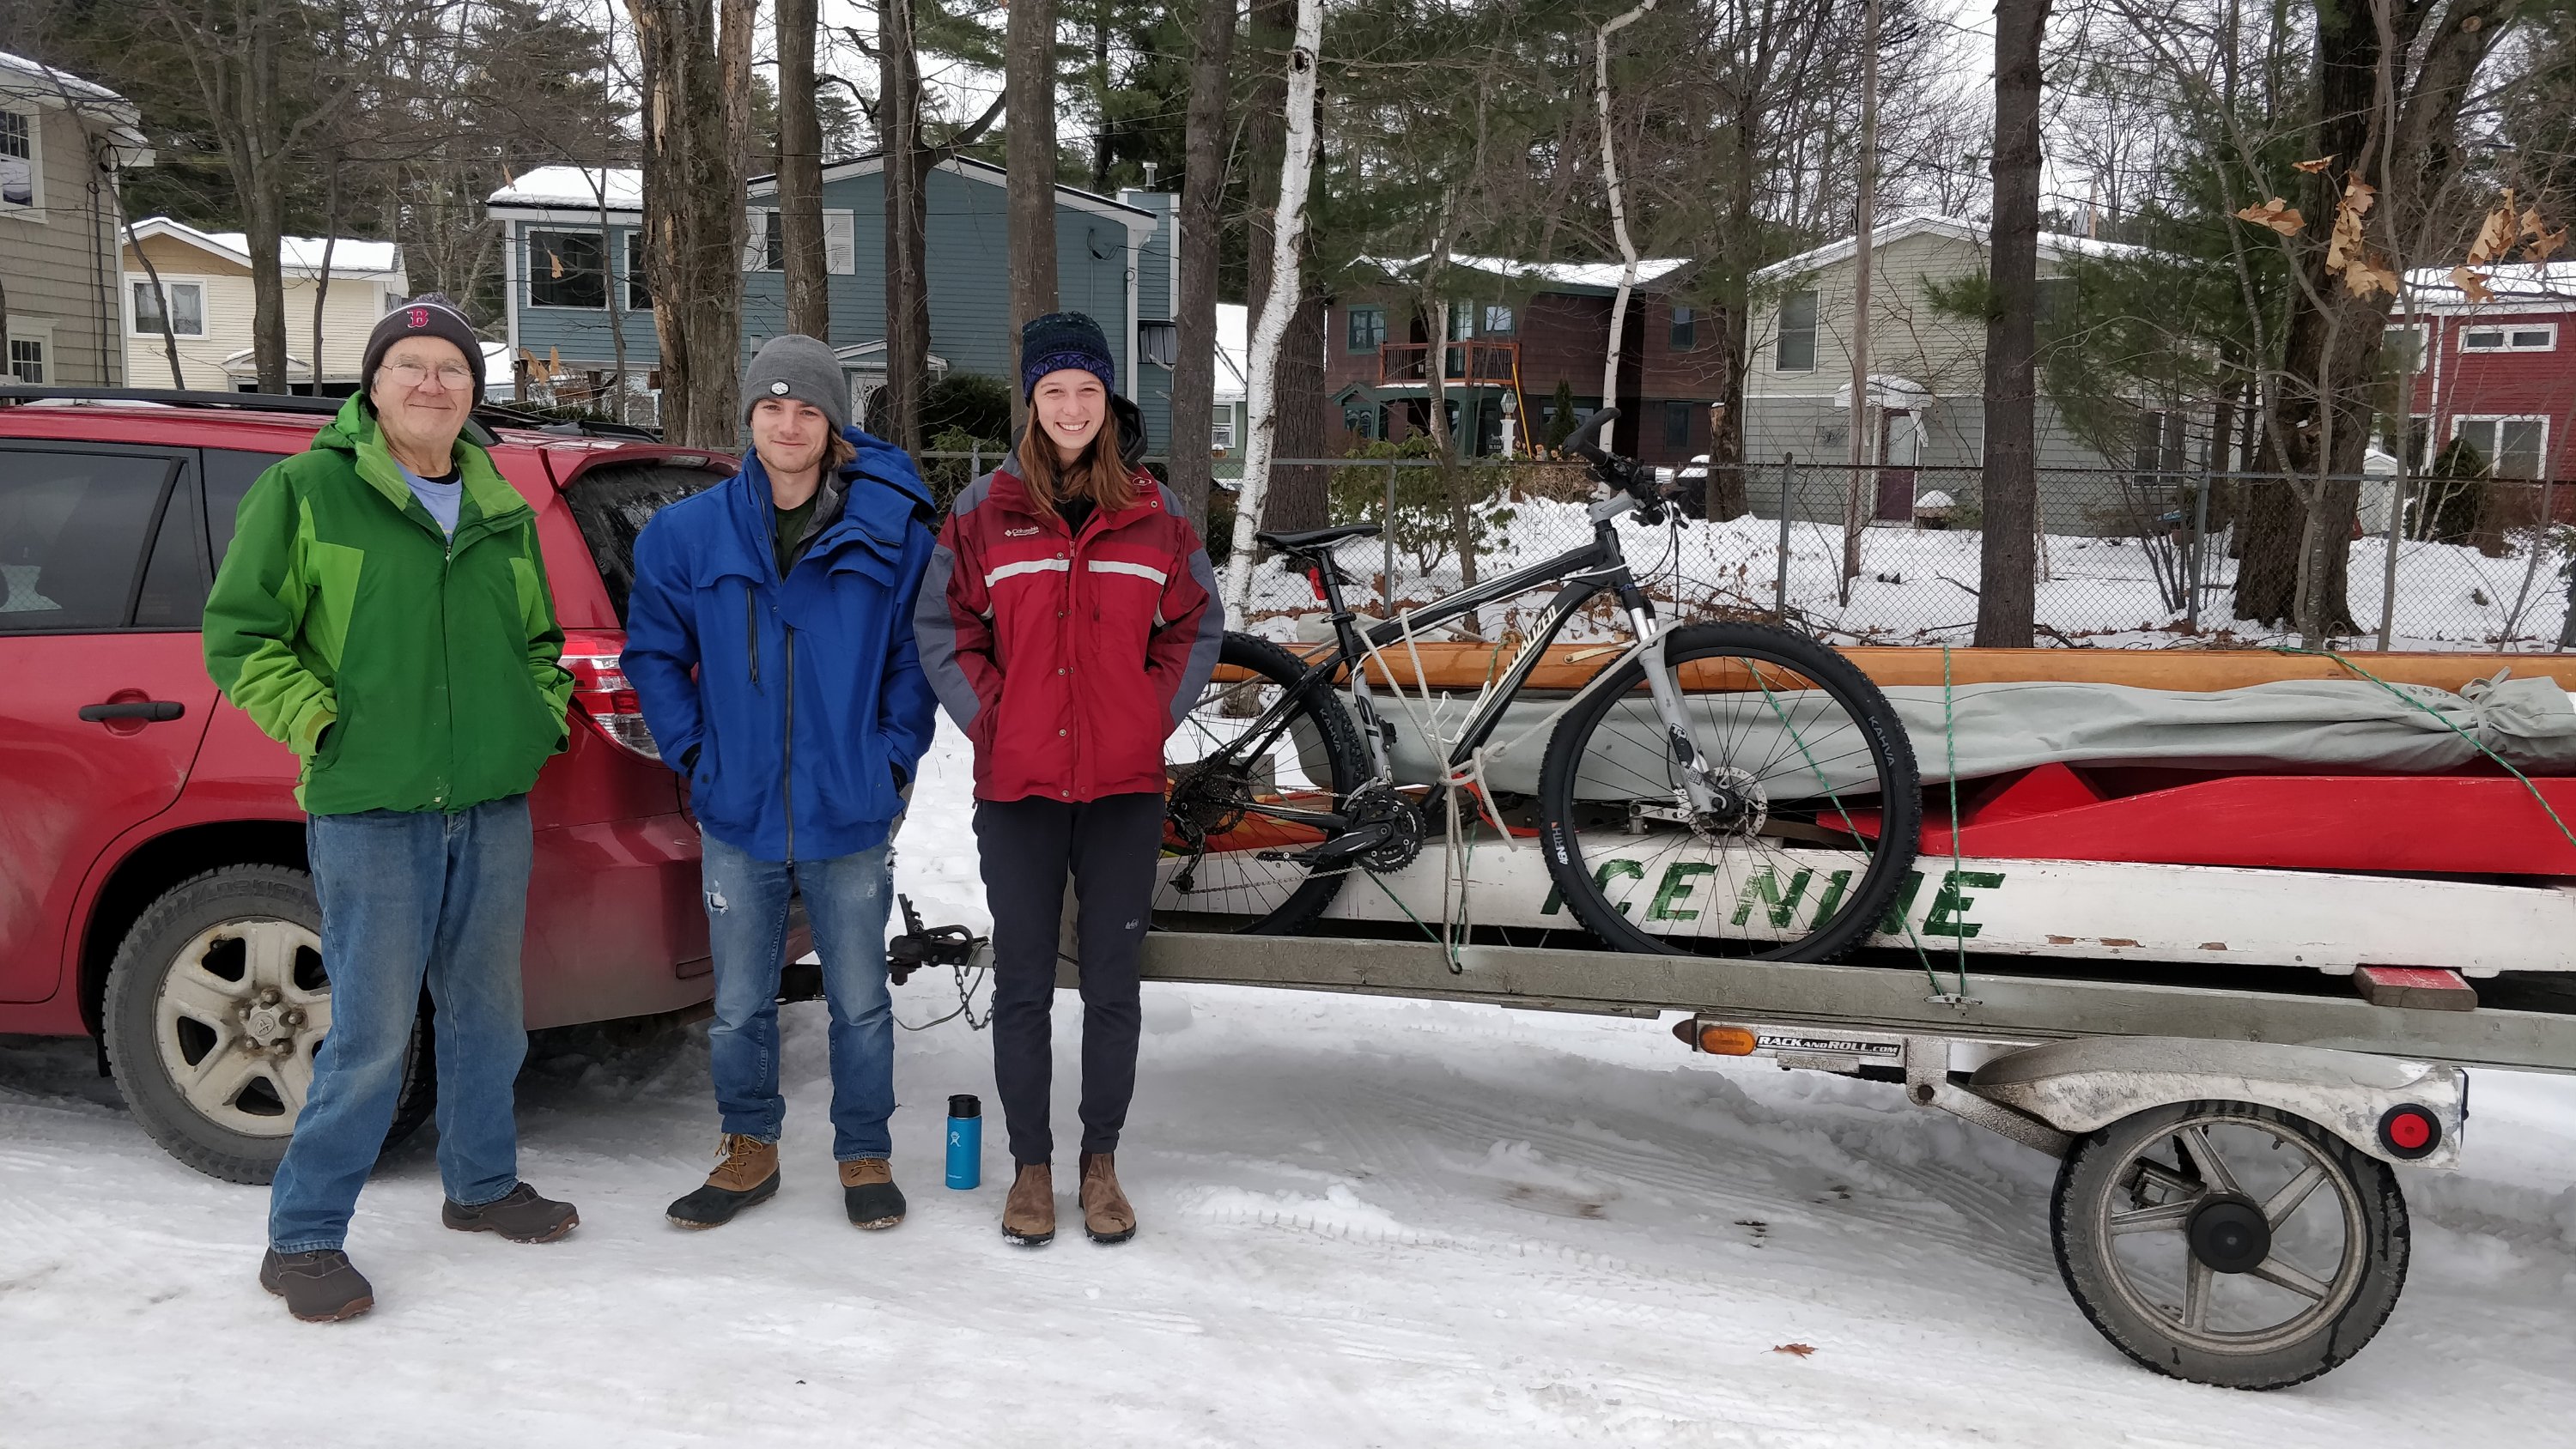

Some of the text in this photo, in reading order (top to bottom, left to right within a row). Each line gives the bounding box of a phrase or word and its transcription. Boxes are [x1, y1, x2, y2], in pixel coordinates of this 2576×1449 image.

[406, 307, 429, 328] B
[1495, 604, 1558, 685] IALIZED
[1319, 708, 1341, 753] KAHVA
[1868, 715, 1895, 767] KAHVA
